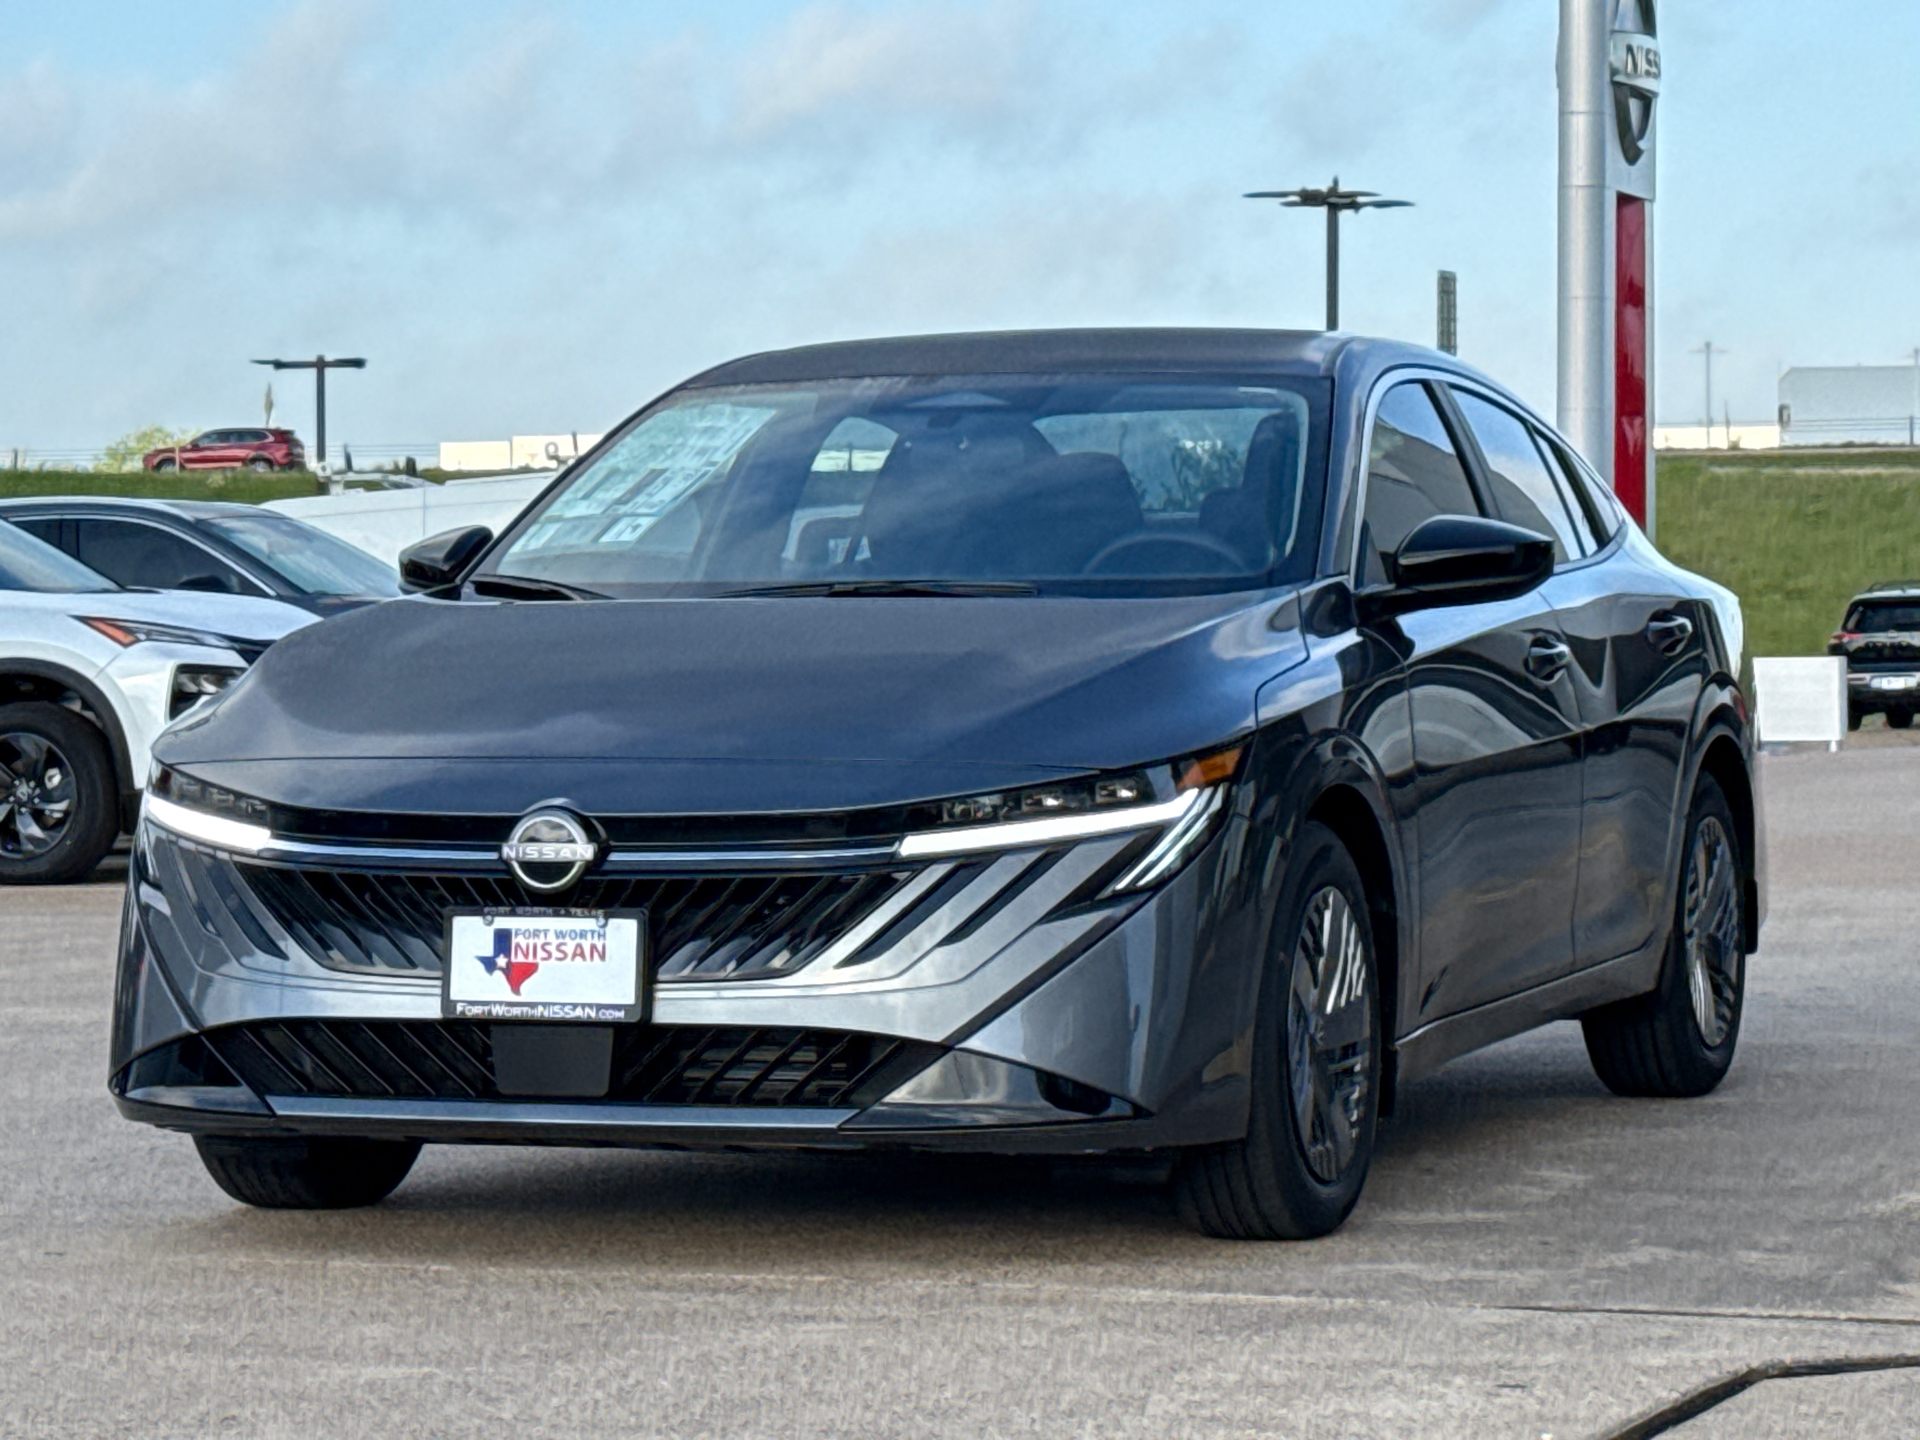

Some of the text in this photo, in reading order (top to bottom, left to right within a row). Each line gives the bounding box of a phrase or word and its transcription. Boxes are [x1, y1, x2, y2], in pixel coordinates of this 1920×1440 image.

[503, 845, 592, 859] NISSAN
[483, 906, 511, 915] FORT
[516, 906, 553, 916] WORTH
[514, 928, 606, 942] FORT WORTH
[514, 942, 606, 962] NISSAN
